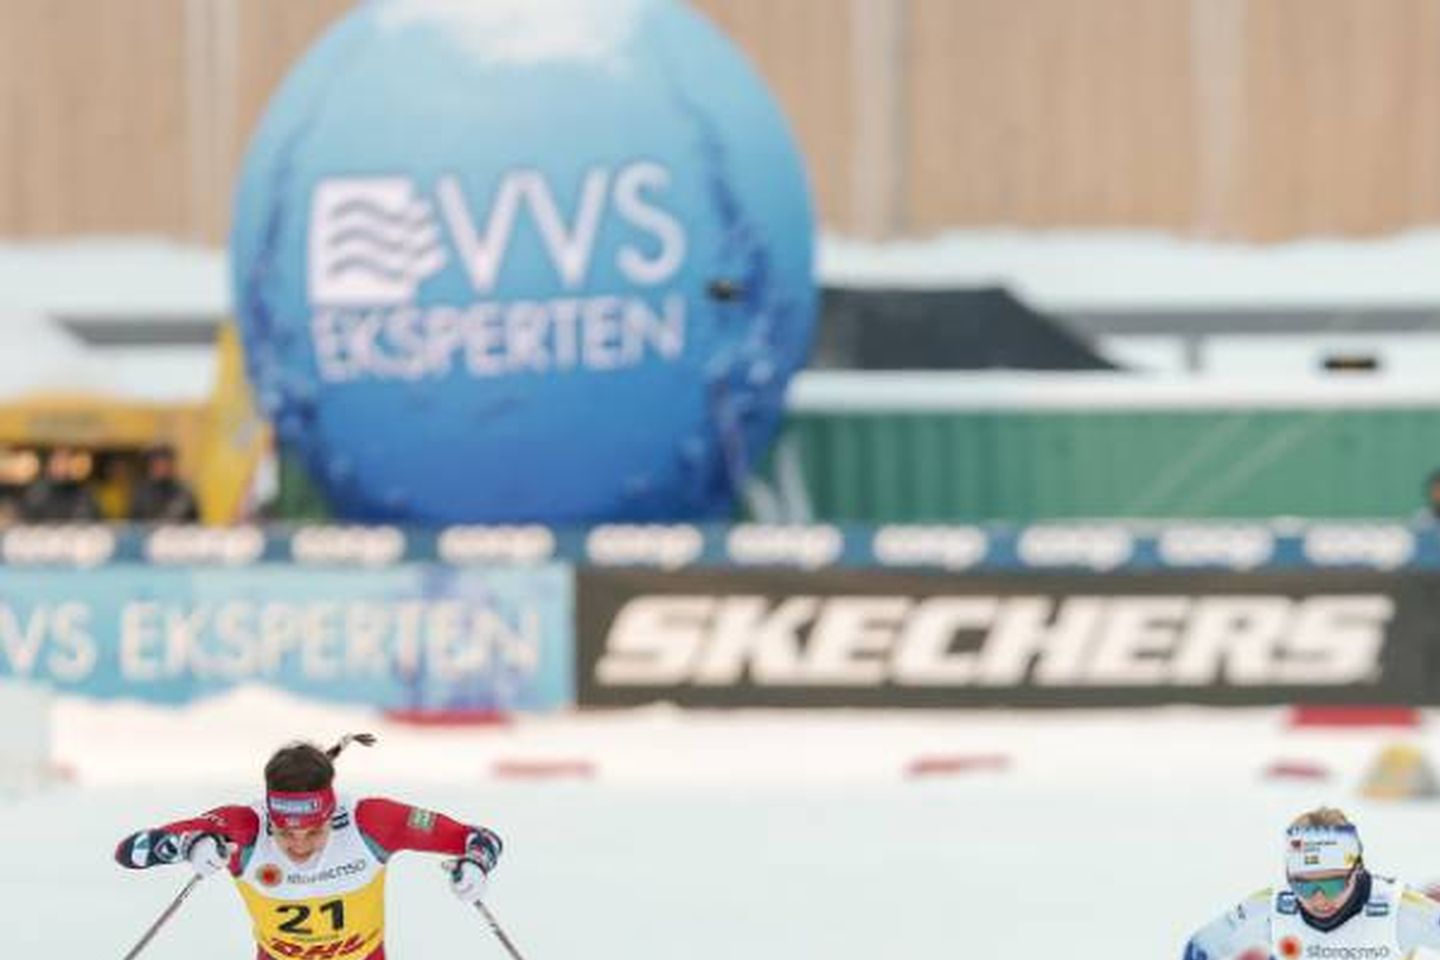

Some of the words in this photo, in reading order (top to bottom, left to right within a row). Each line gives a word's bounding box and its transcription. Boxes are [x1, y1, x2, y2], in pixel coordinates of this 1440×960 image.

[437, 162, 687, 293] VVS
[310, 294, 686, 383] EKSPERTEN
[119, 600, 538, 682] EKSPERTEN
[594, 596, 1395, 686] SKECHERS
[276, 899, 345, 935] 21
